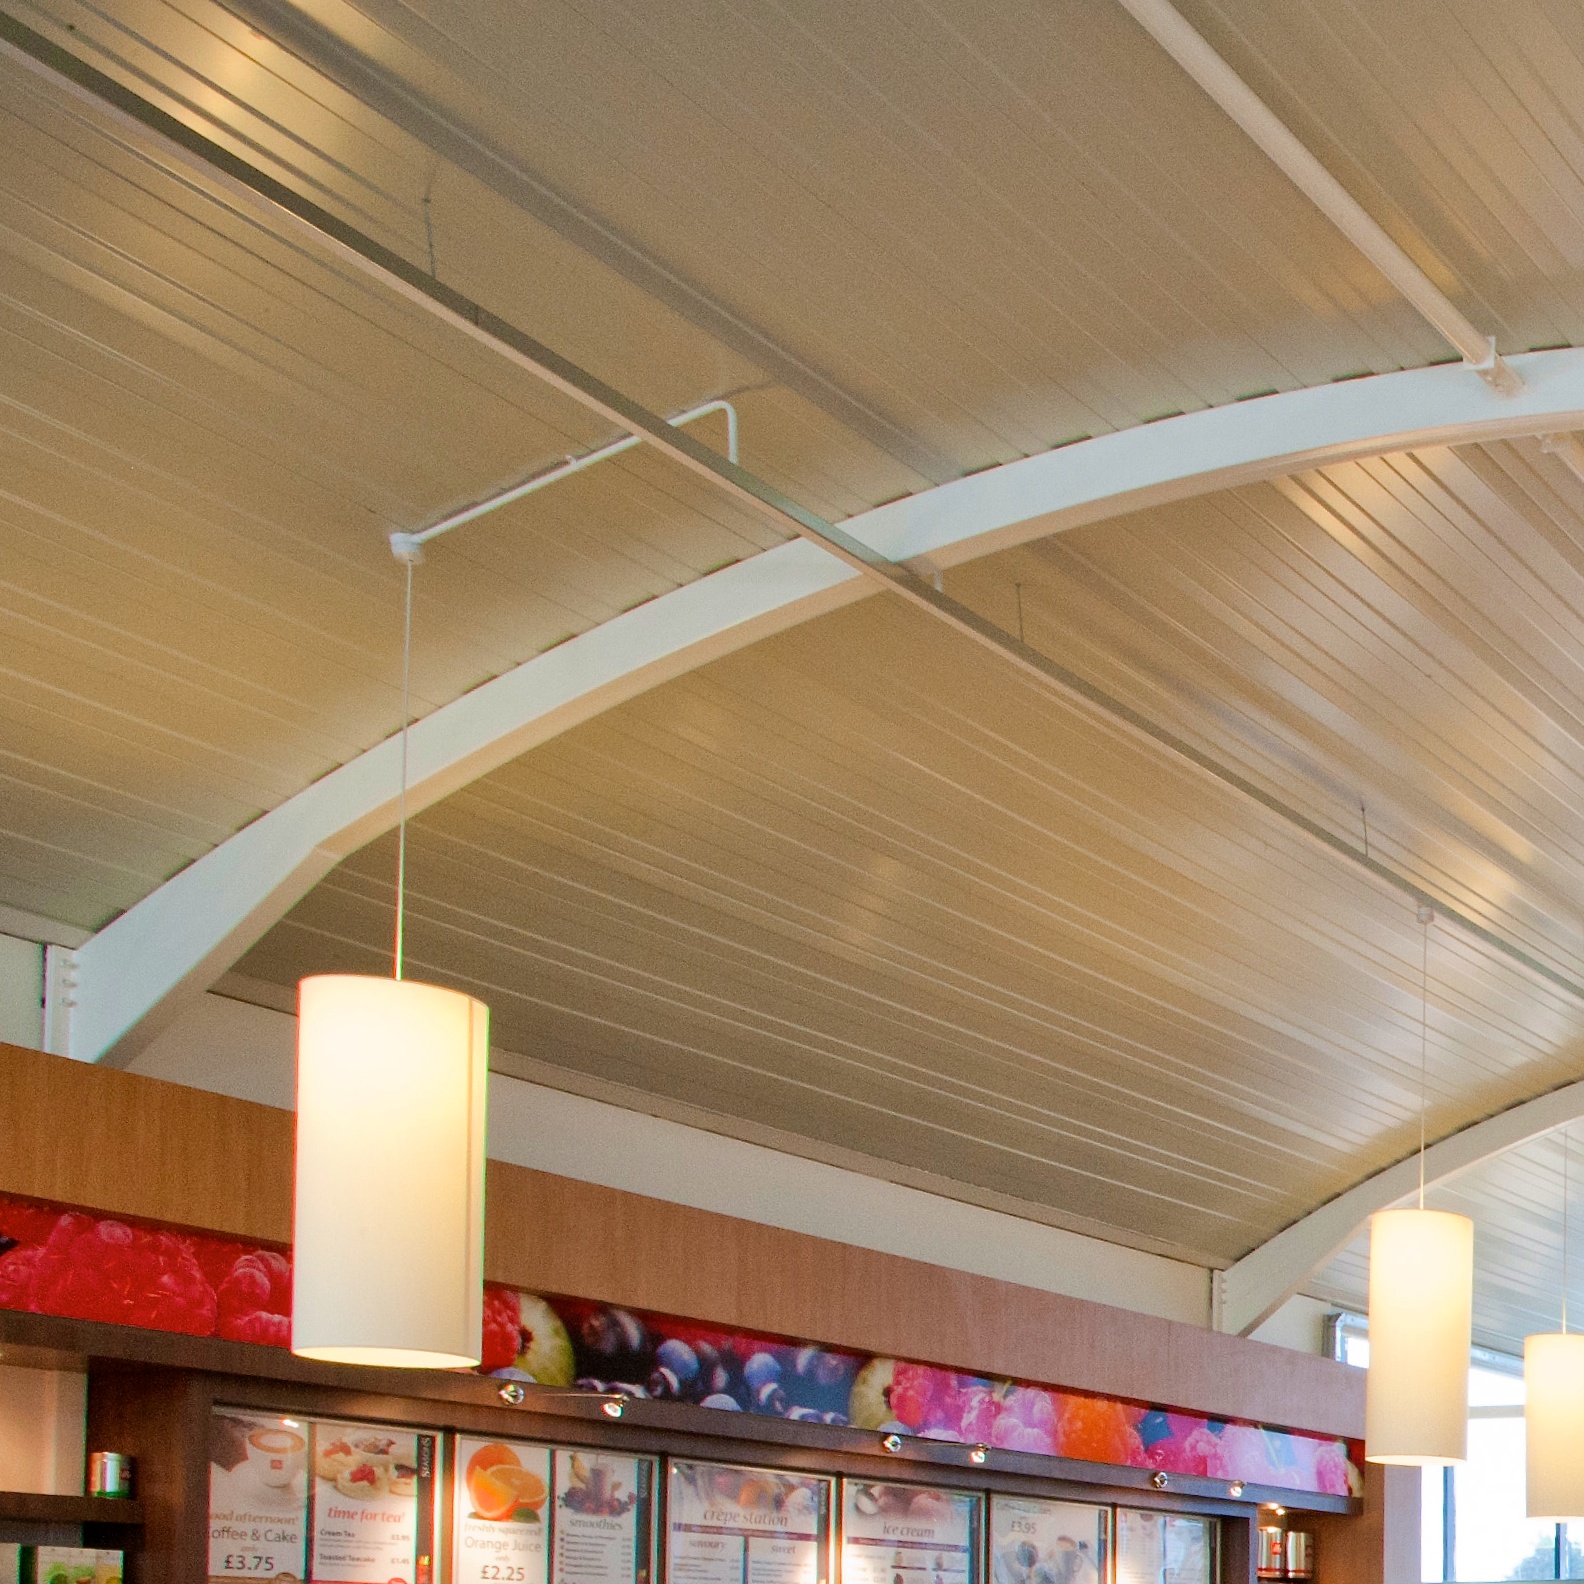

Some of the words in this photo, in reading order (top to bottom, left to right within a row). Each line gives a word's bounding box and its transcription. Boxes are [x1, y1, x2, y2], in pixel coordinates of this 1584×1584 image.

[328, 1506, 358, 1519] time
[360, 1509, 378, 1522] for
[743, 1511, 788, 1527] station
[212, 1526, 248, 1541] offee
[264, 1529, 298, 1543] Cake
[883, 1522, 899, 1535] ice
[901, 1525, 935, 1539] cream
[465, 1536, 509, 1553] Orange
[512, 1539, 541, 1552] Juice
[224, 1554, 274, 1571] £3.75
[481, 1565, 525, 1582] £2.25
